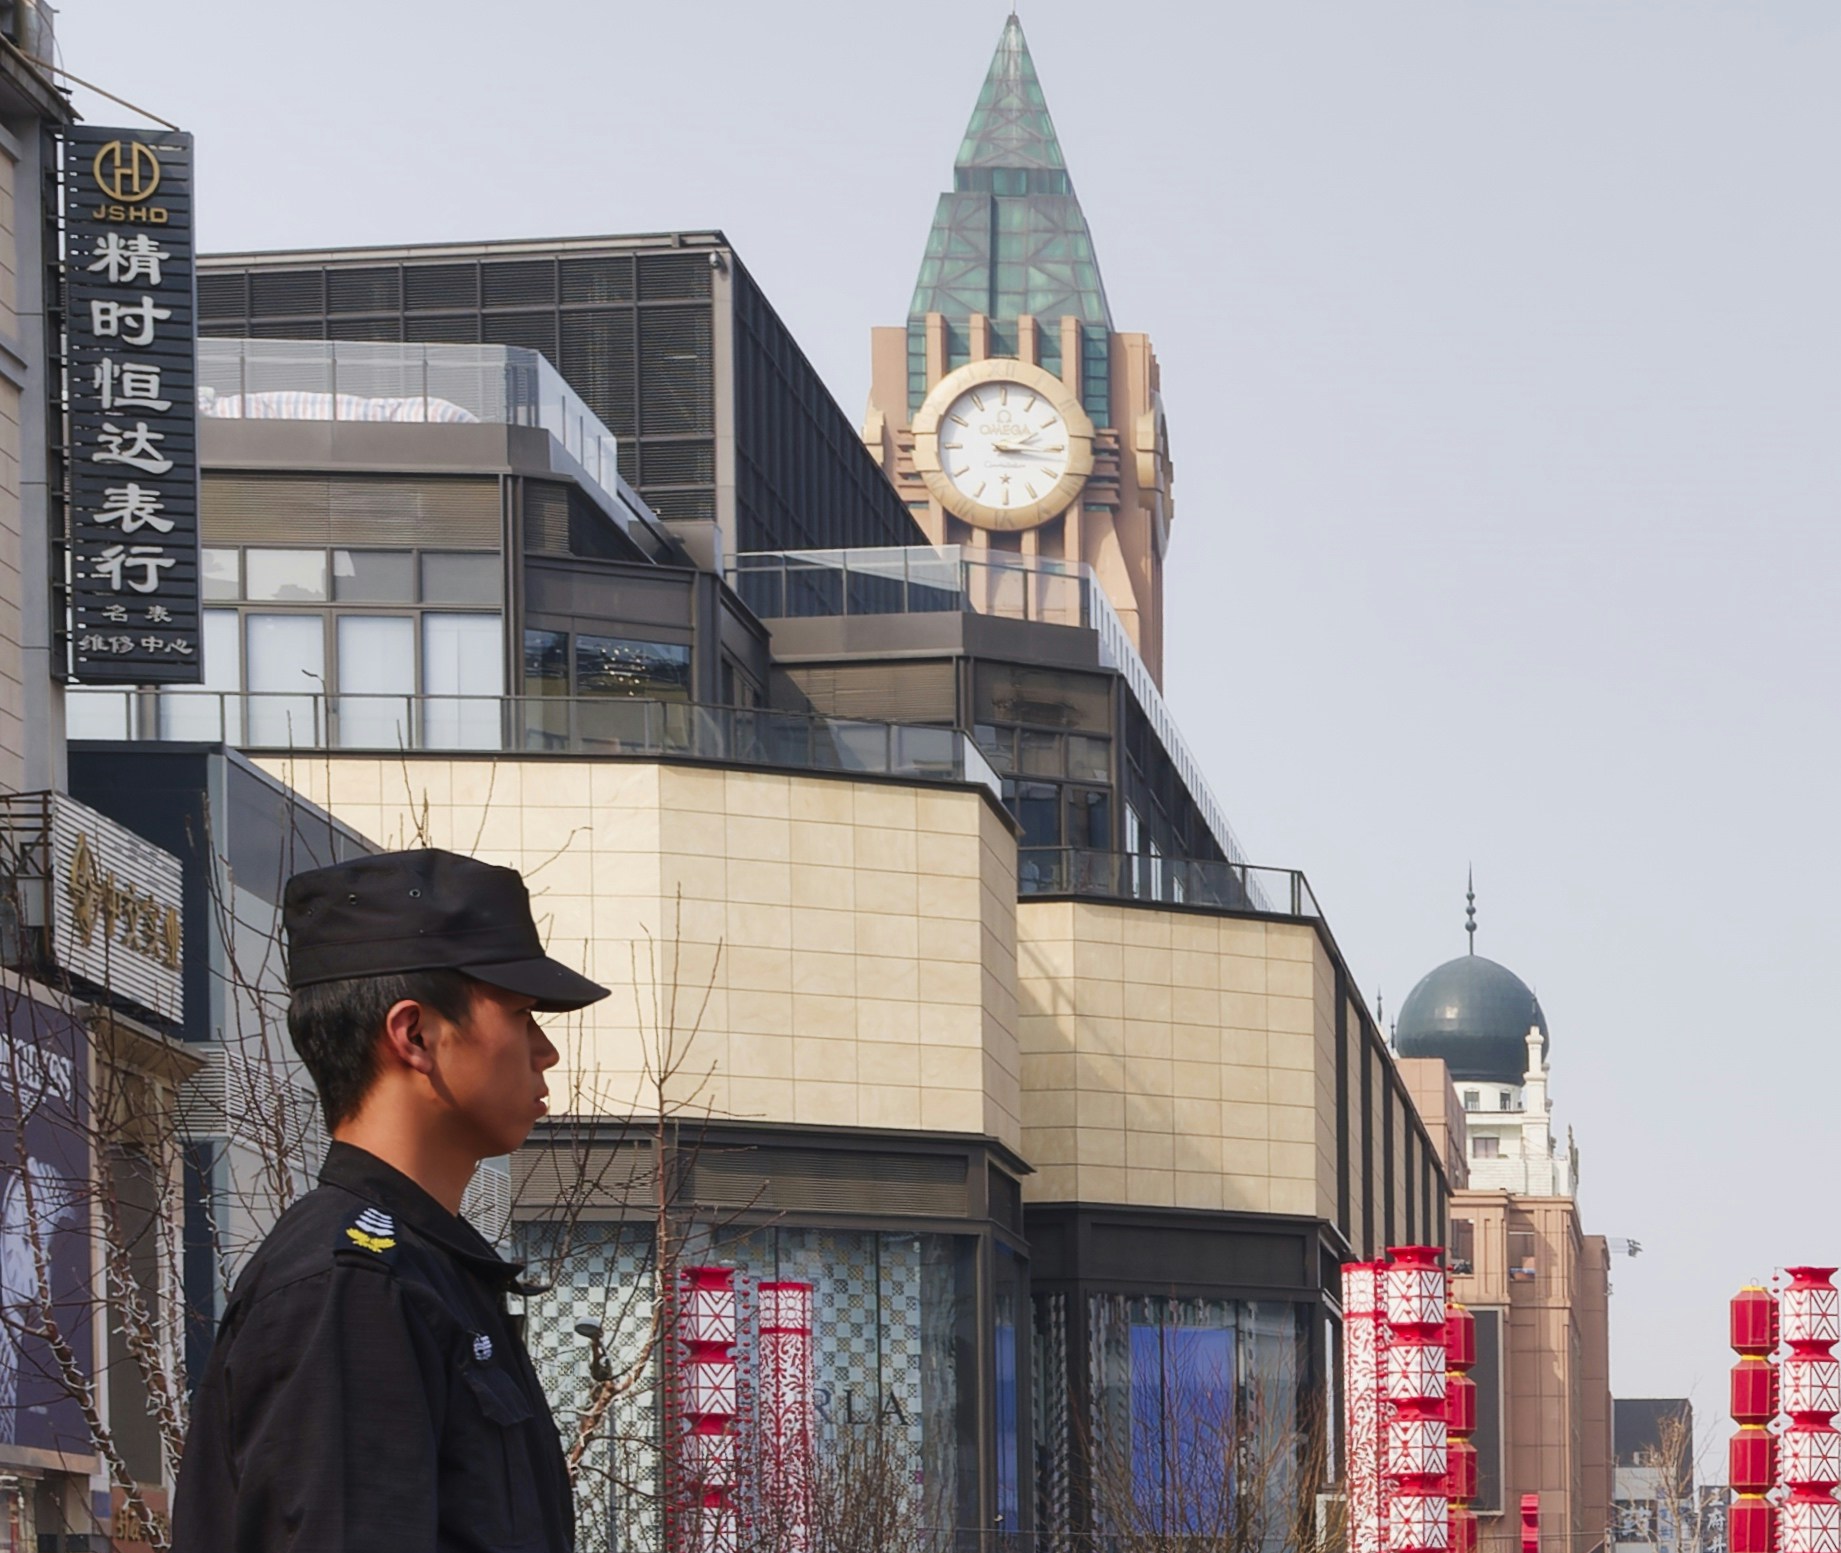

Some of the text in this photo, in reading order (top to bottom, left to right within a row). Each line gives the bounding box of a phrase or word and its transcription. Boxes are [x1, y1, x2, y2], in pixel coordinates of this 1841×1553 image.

[92, 204, 169, 224] JSHD
[87, 230, 177, 596] 精时恒达表行
[979, 424, 1031, 435] OMEGA
[102, 604, 173, 624] 名表
[79, 634, 193, 656] 维修中心
